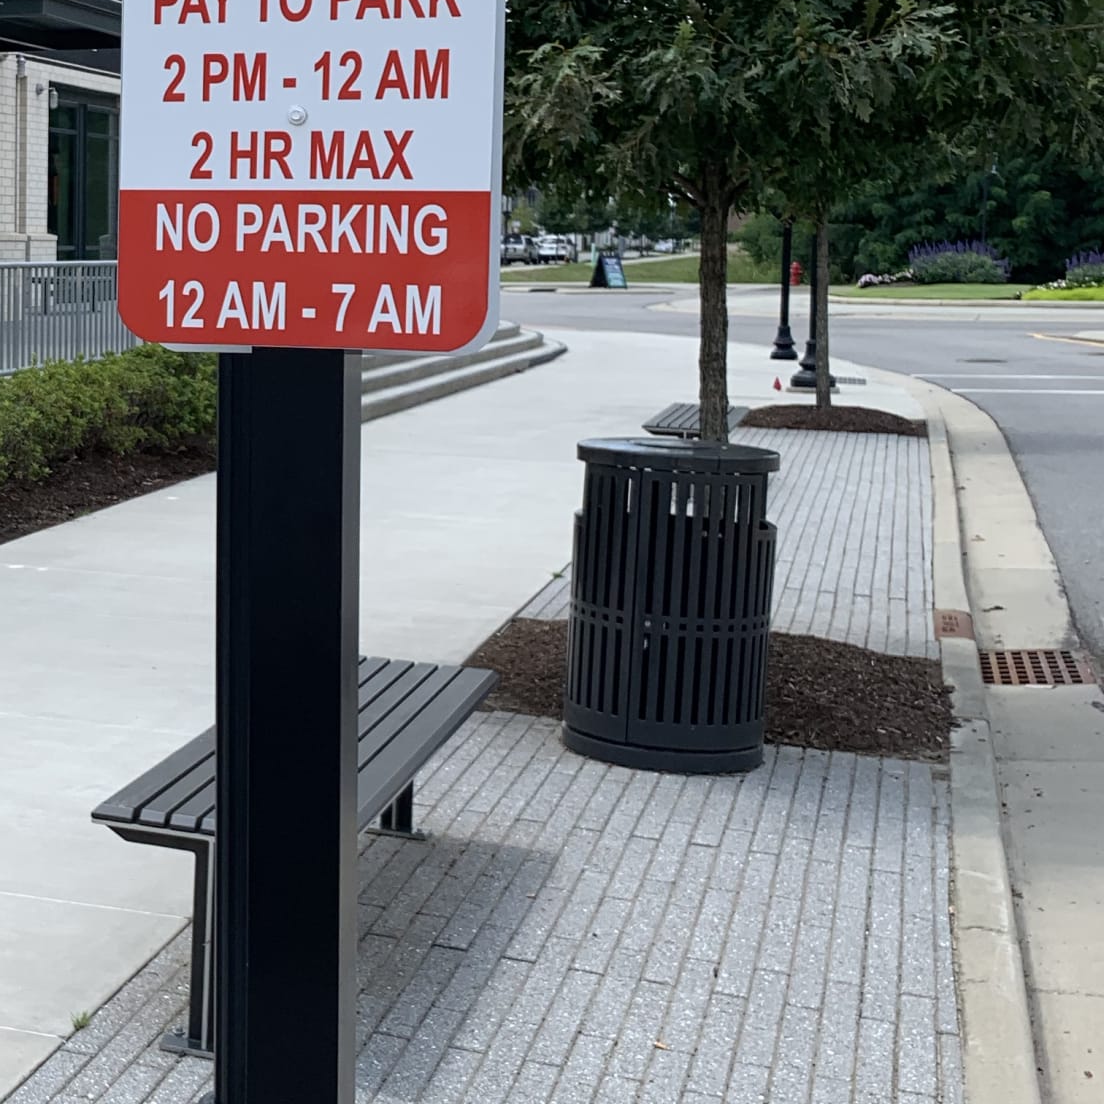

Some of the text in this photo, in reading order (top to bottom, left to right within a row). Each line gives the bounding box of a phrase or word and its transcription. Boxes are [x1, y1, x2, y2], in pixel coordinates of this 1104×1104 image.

[164, 49, 449, 102] 2 PM - 12 AM
[191, 131, 412, 179] 2 HR MAX
[156, 203, 447, 255] NO PARKING
[160, 280, 441, 334] 12 AM - 7 AM
